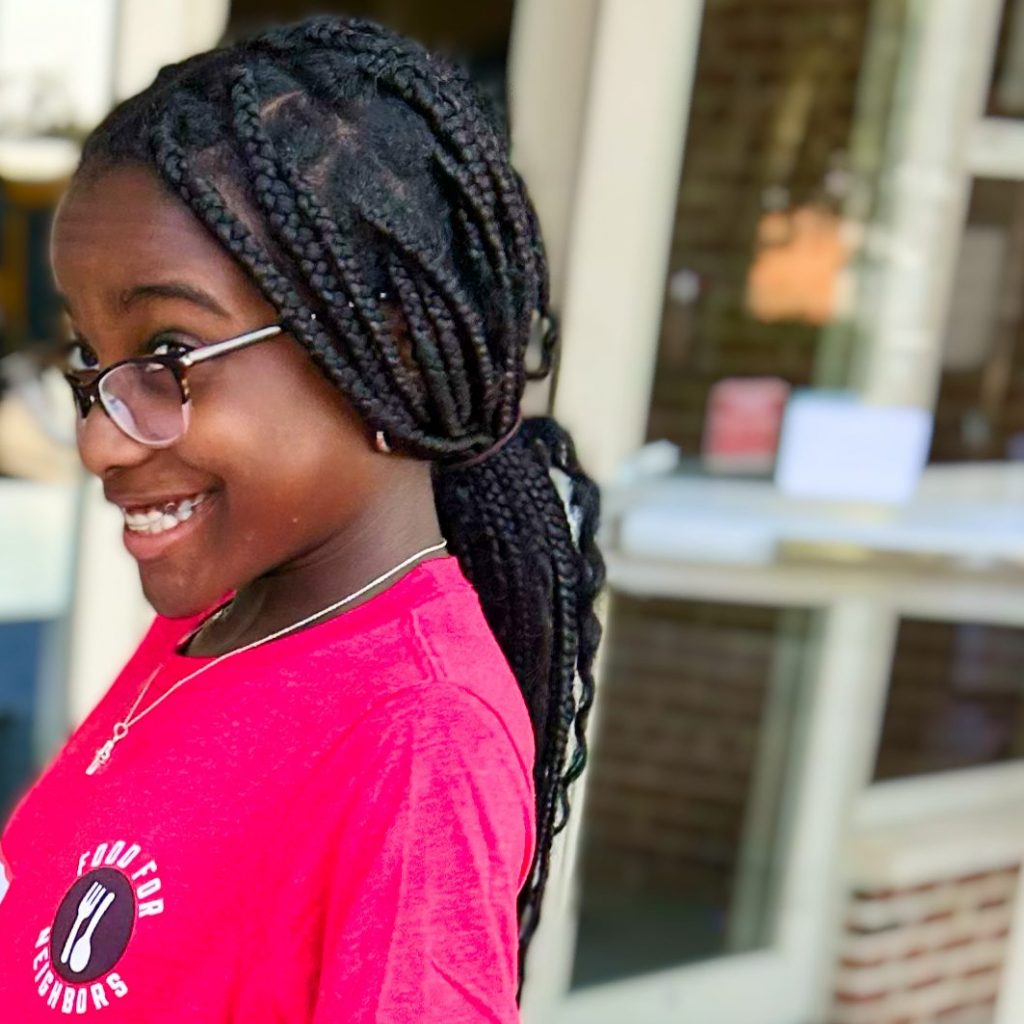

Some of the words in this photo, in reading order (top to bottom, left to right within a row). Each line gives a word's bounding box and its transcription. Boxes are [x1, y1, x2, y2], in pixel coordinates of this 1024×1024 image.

[77, 840, 141, 876] FOOD
[131, 860, 164, 918] FOR
[33, 925, 128, 1014] NEIGHBORS
